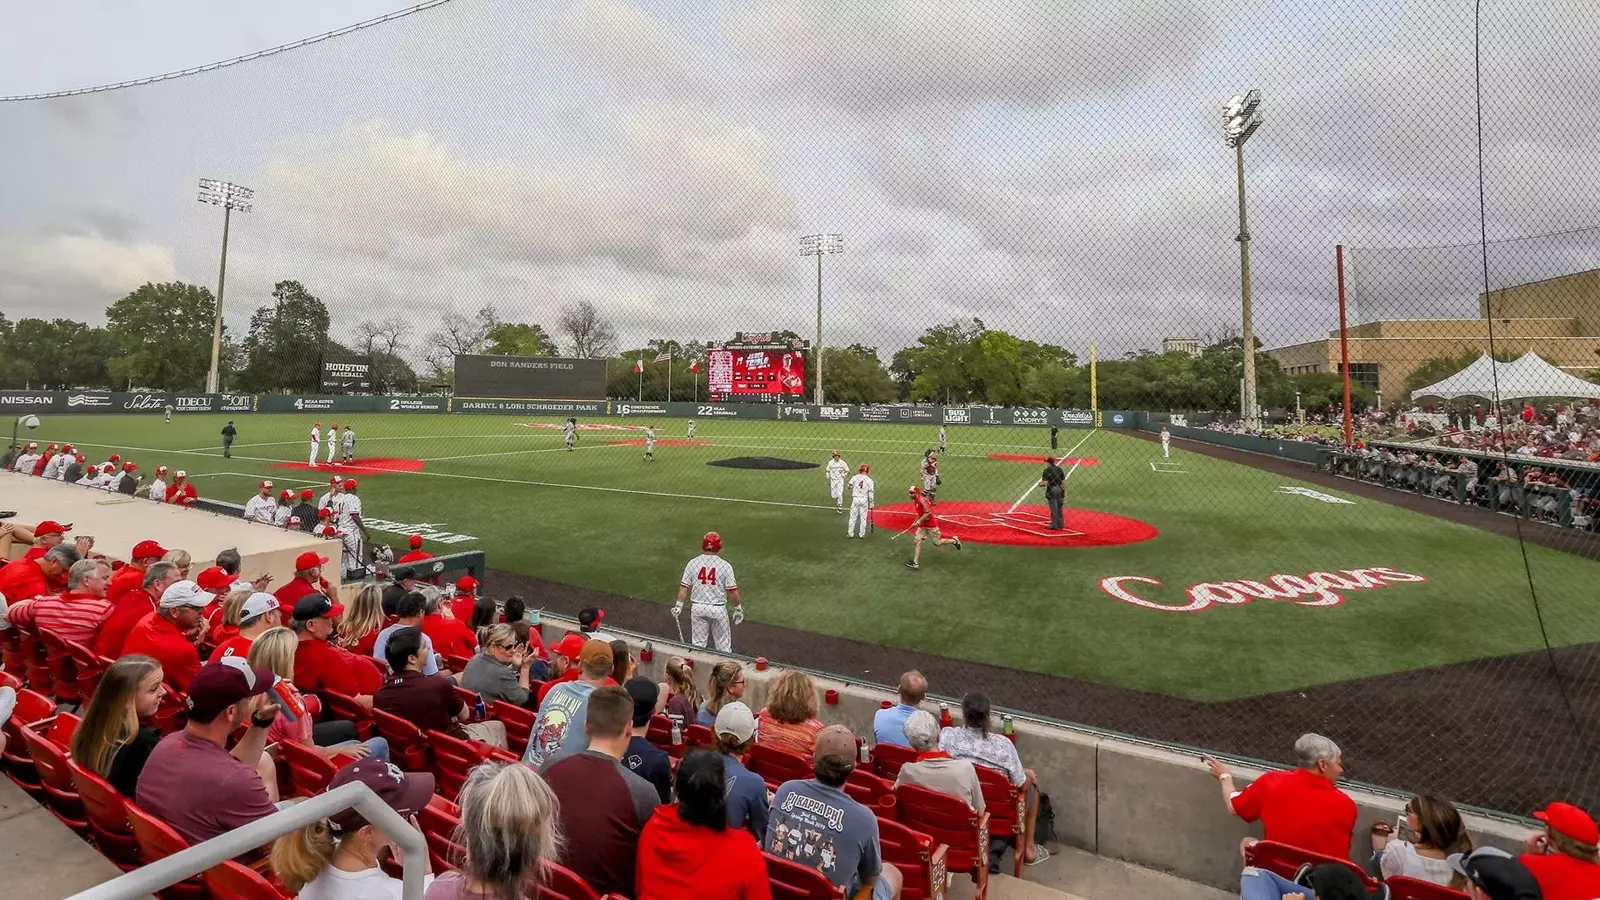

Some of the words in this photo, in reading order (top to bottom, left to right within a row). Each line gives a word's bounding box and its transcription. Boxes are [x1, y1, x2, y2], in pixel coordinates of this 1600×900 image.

[325, 362, 370, 373] HOUSTON
[509, 361, 549, 369] SANDERS
[1, 396, 53, 404] NISSAN
[175, 397, 213, 406] TDECU
[293, 399, 304, 409] 4
[390, 399, 400, 410] 2
[526, 403, 574, 411] SCHROEDER
[616, 404, 630, 414] 16
[697, 405, 713, 416] 22
[858, 480, 864, 490] 4
[697, 566, 717, 586] 44
[1098, 566, 1429, 613] Cougars
[794, 794, 826, 816] KAPPA
[824, 804, 845, 832] PHI
